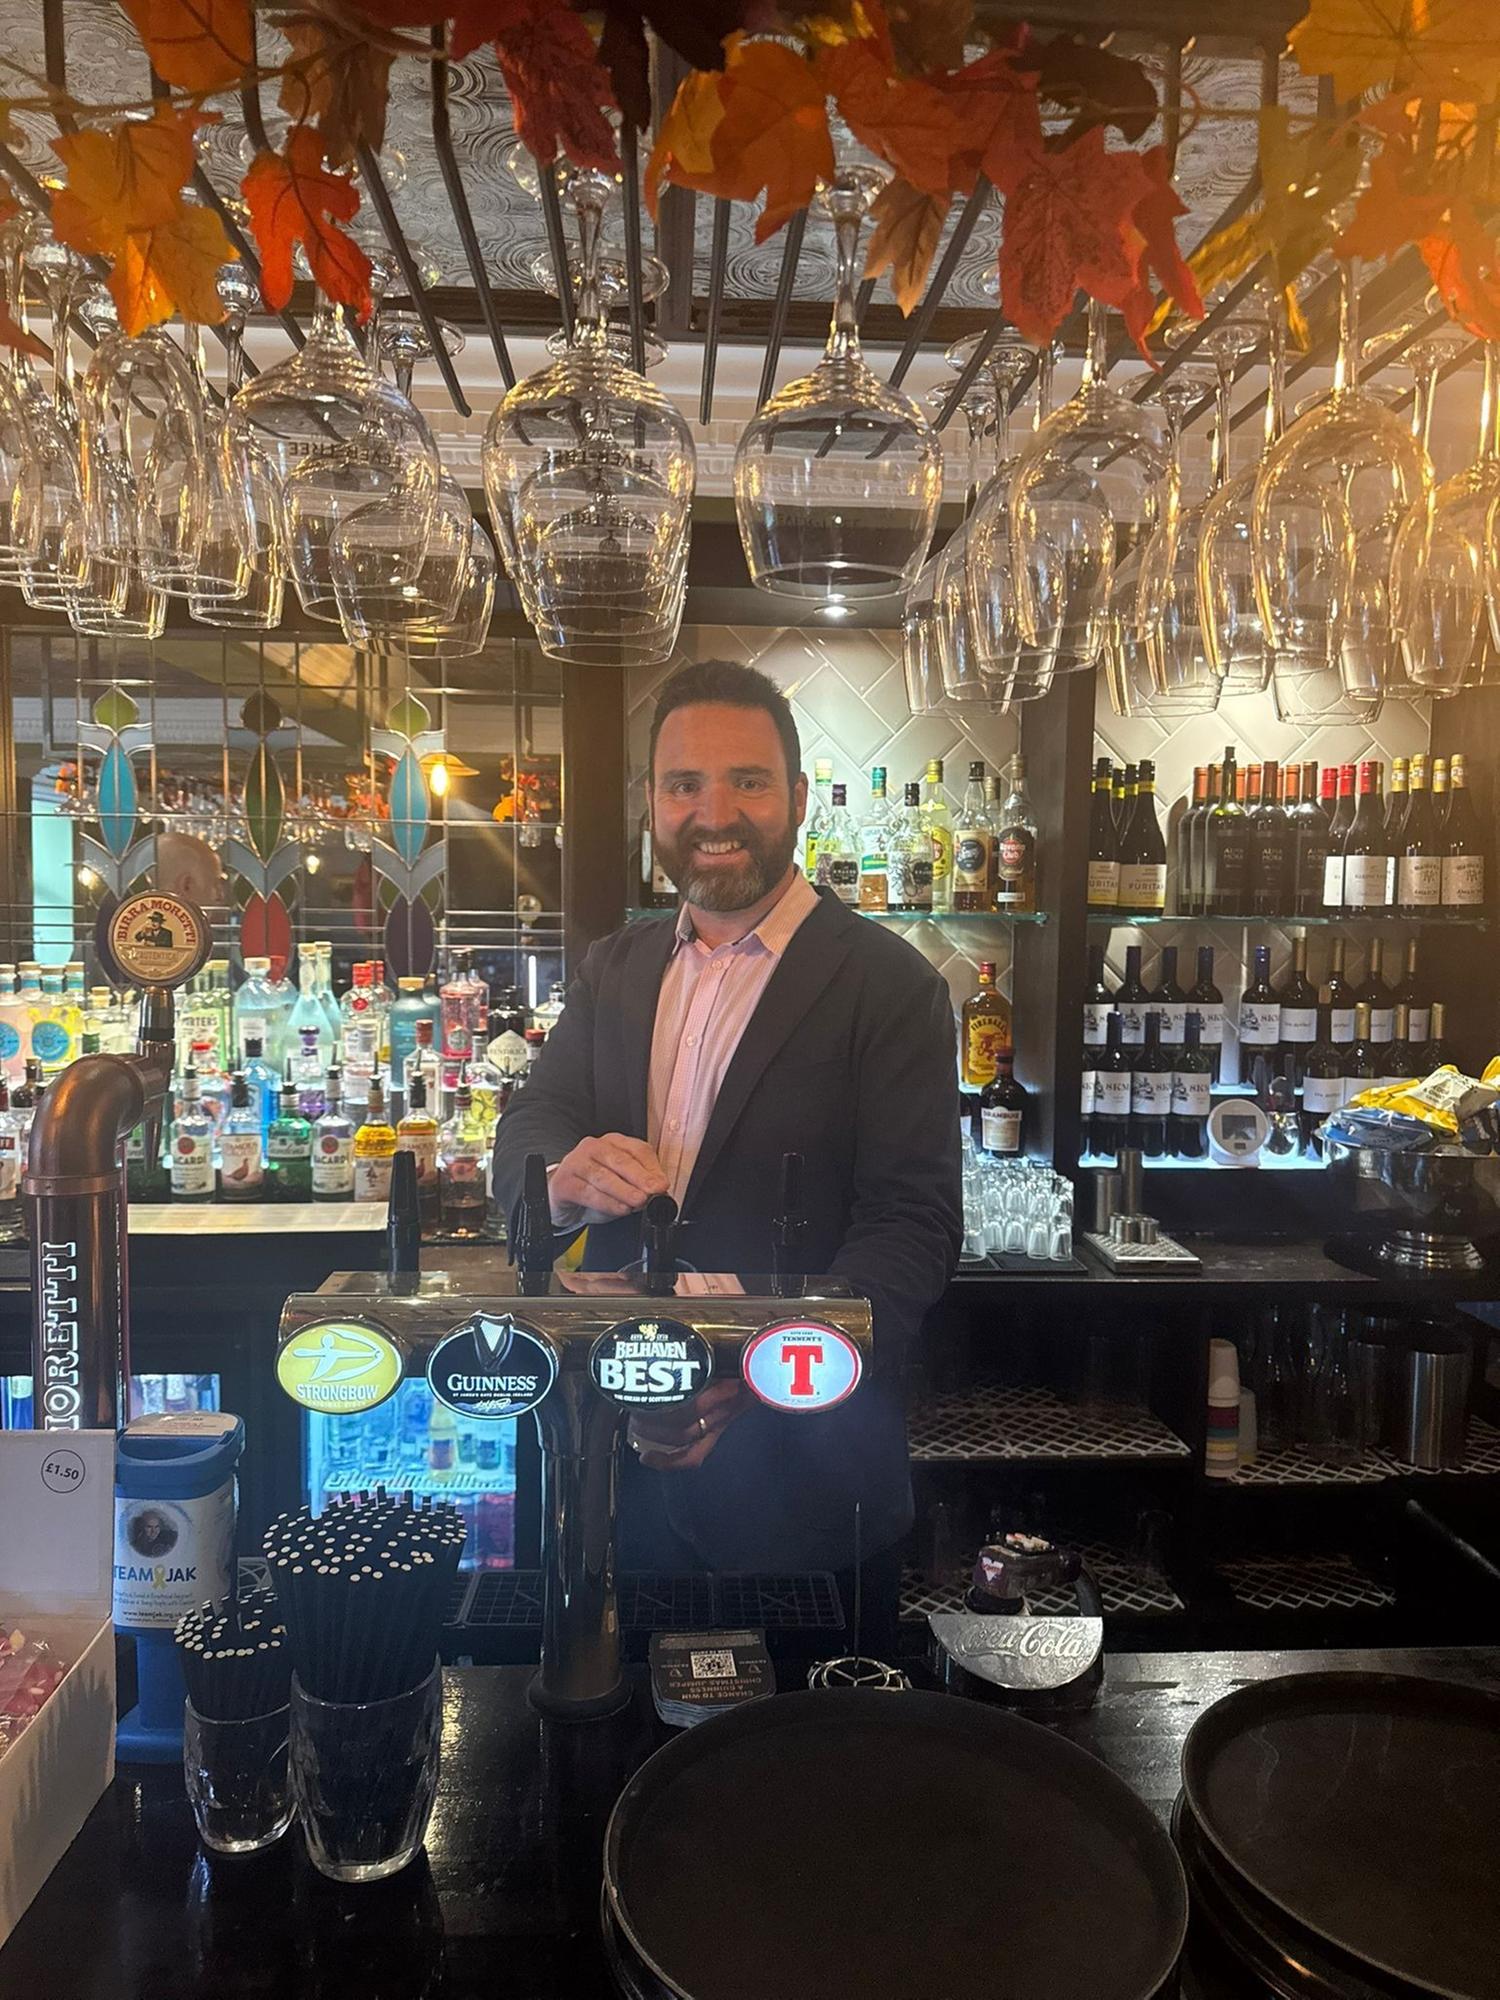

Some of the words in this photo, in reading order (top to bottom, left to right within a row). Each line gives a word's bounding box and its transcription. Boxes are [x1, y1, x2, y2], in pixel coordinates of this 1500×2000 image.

[116, 902, 150, 942] BIRRA
[150, 900, 197, 944] MORETTI
[615, 1341, 687, 1359] BELHAVEN
[600, 1358, 700, 1393] BEST
[782, 1345, 823, 1395] T
[447, 1373, 537, 1391] GUINNESS
[297, 1383, 378, 1401] STRONGBOW
[45, 1462, 79, 1480] £1.50
[113, 1565, 153, 1581] TEAM
[166, 1567, 197, 1582] JAK
[706, 1678, 762, 1686] CHRISTMAS
